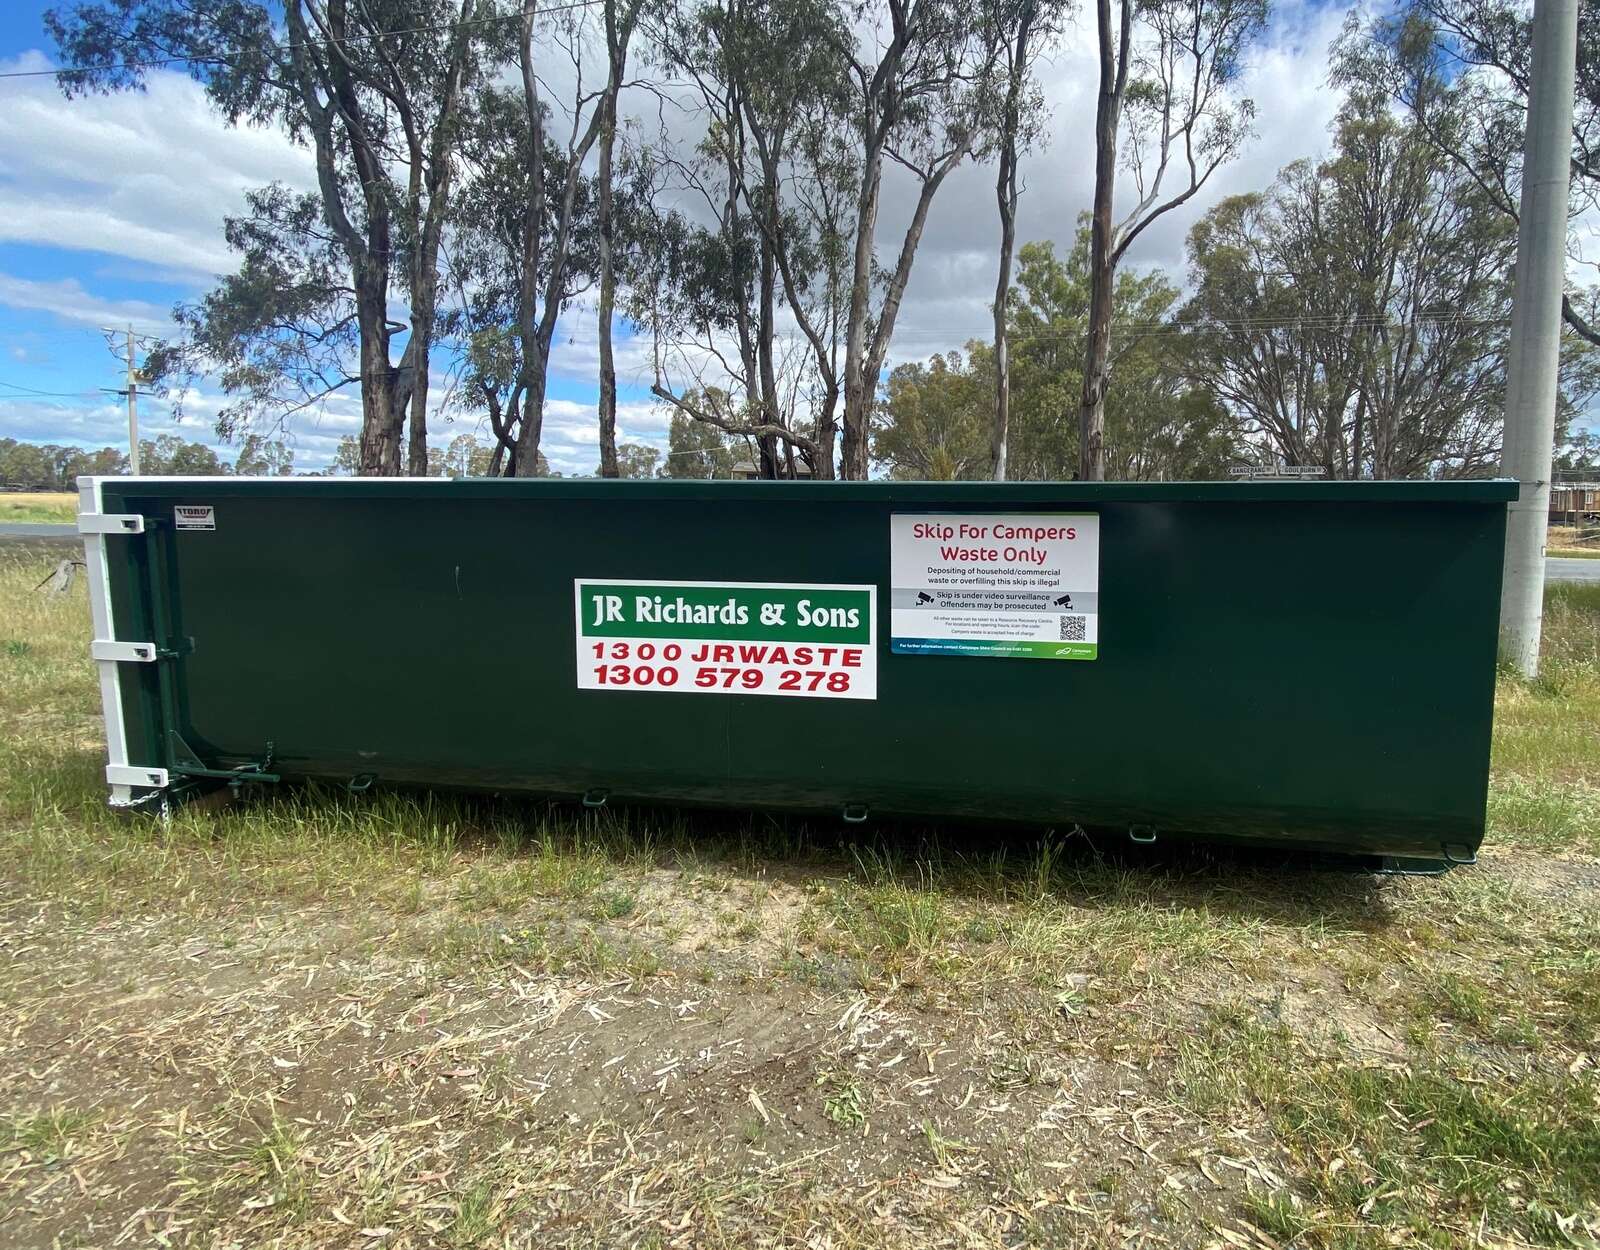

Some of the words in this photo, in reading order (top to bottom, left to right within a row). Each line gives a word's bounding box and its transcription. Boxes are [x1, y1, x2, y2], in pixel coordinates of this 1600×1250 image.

[913, 523, 954, 541] Skip
[959, 524, 988, 539] For
[992, 524, 1076, 542] Campers
[940, 546, 998, 561] Waste
[1003, 547, 1047, 565] Only
[927, 566, 966, 575] Depositing
[967, 567, 975, 575] of
[976, 567, 1061, 576] household/commercial
[959, 577, 996, 586] overfilling
[1012, 578, 1028, 586] skip
[1037, 579, 1060, 587] illegal
[936, 591, 953, 600] Skip
[1006, 592, 1050, 601] surveillance
[592, 595, 625, 626] JR
[635, 596, 749, 625] Richards
[759, 602, 787, 626] &
[797, 600, 860, 628] Sons
[1004, 602, 1047, 611] prosecuted
[691, 645, 863, 667] JRWASTE
[594, 664, 679, 686] 1300
[695, 667, 764, 689] 579
[778, 670, 850, 692] 278
